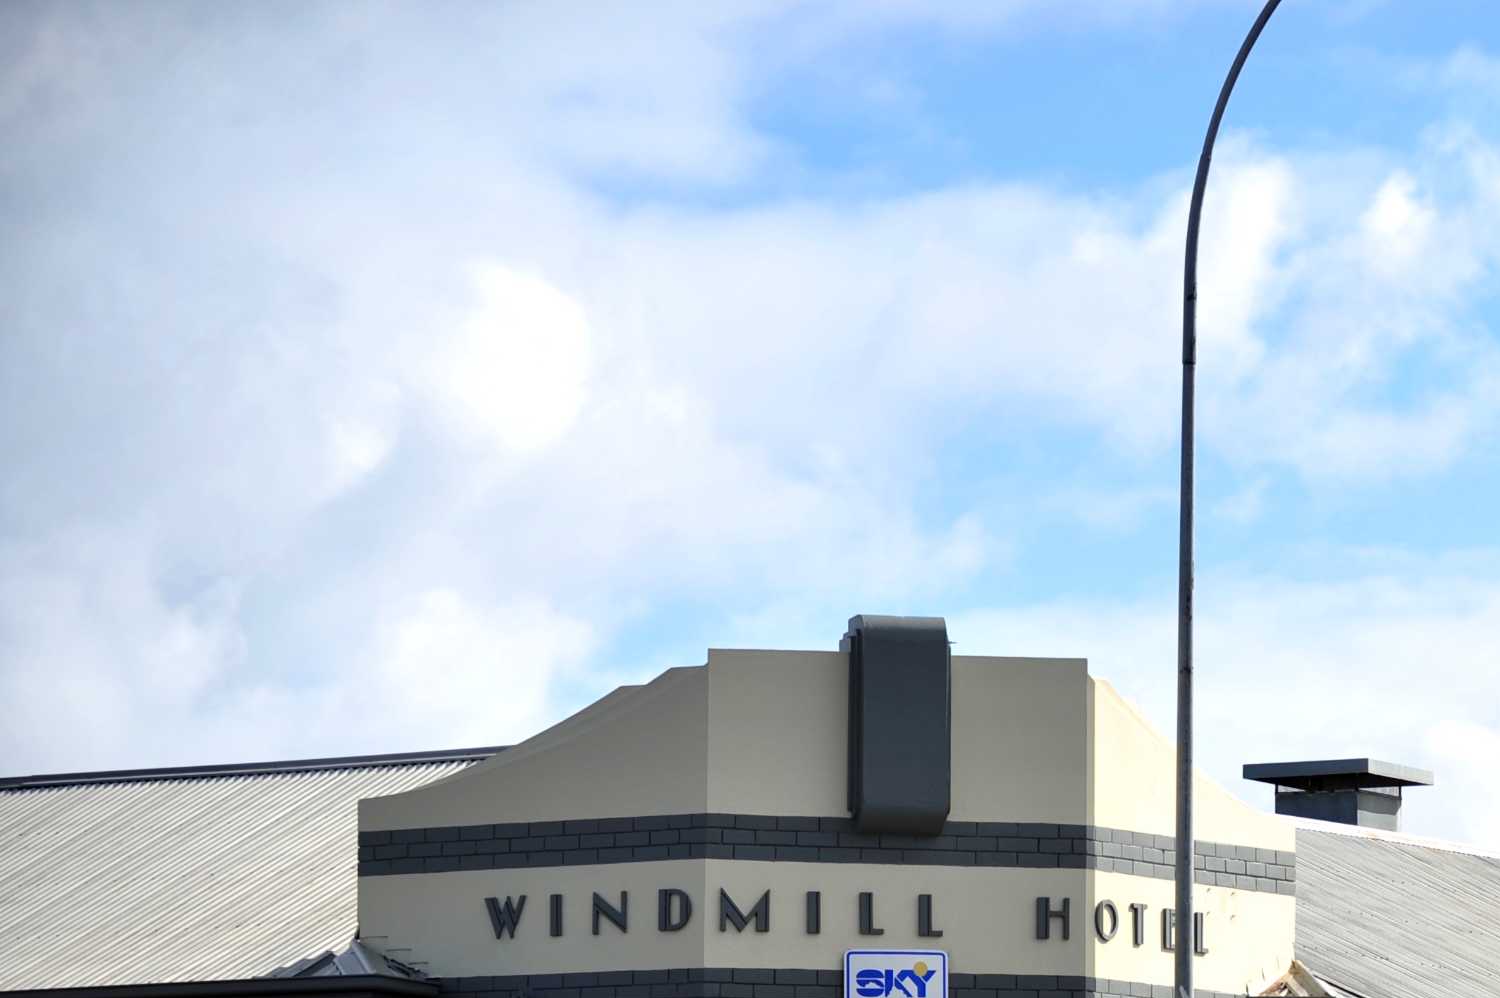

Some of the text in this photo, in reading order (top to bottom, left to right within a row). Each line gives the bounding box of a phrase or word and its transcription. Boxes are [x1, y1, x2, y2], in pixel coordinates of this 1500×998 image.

[484, 887, 1208, 956] WINDMILL HOTEL
[856, 969, 937, 998] SKY
